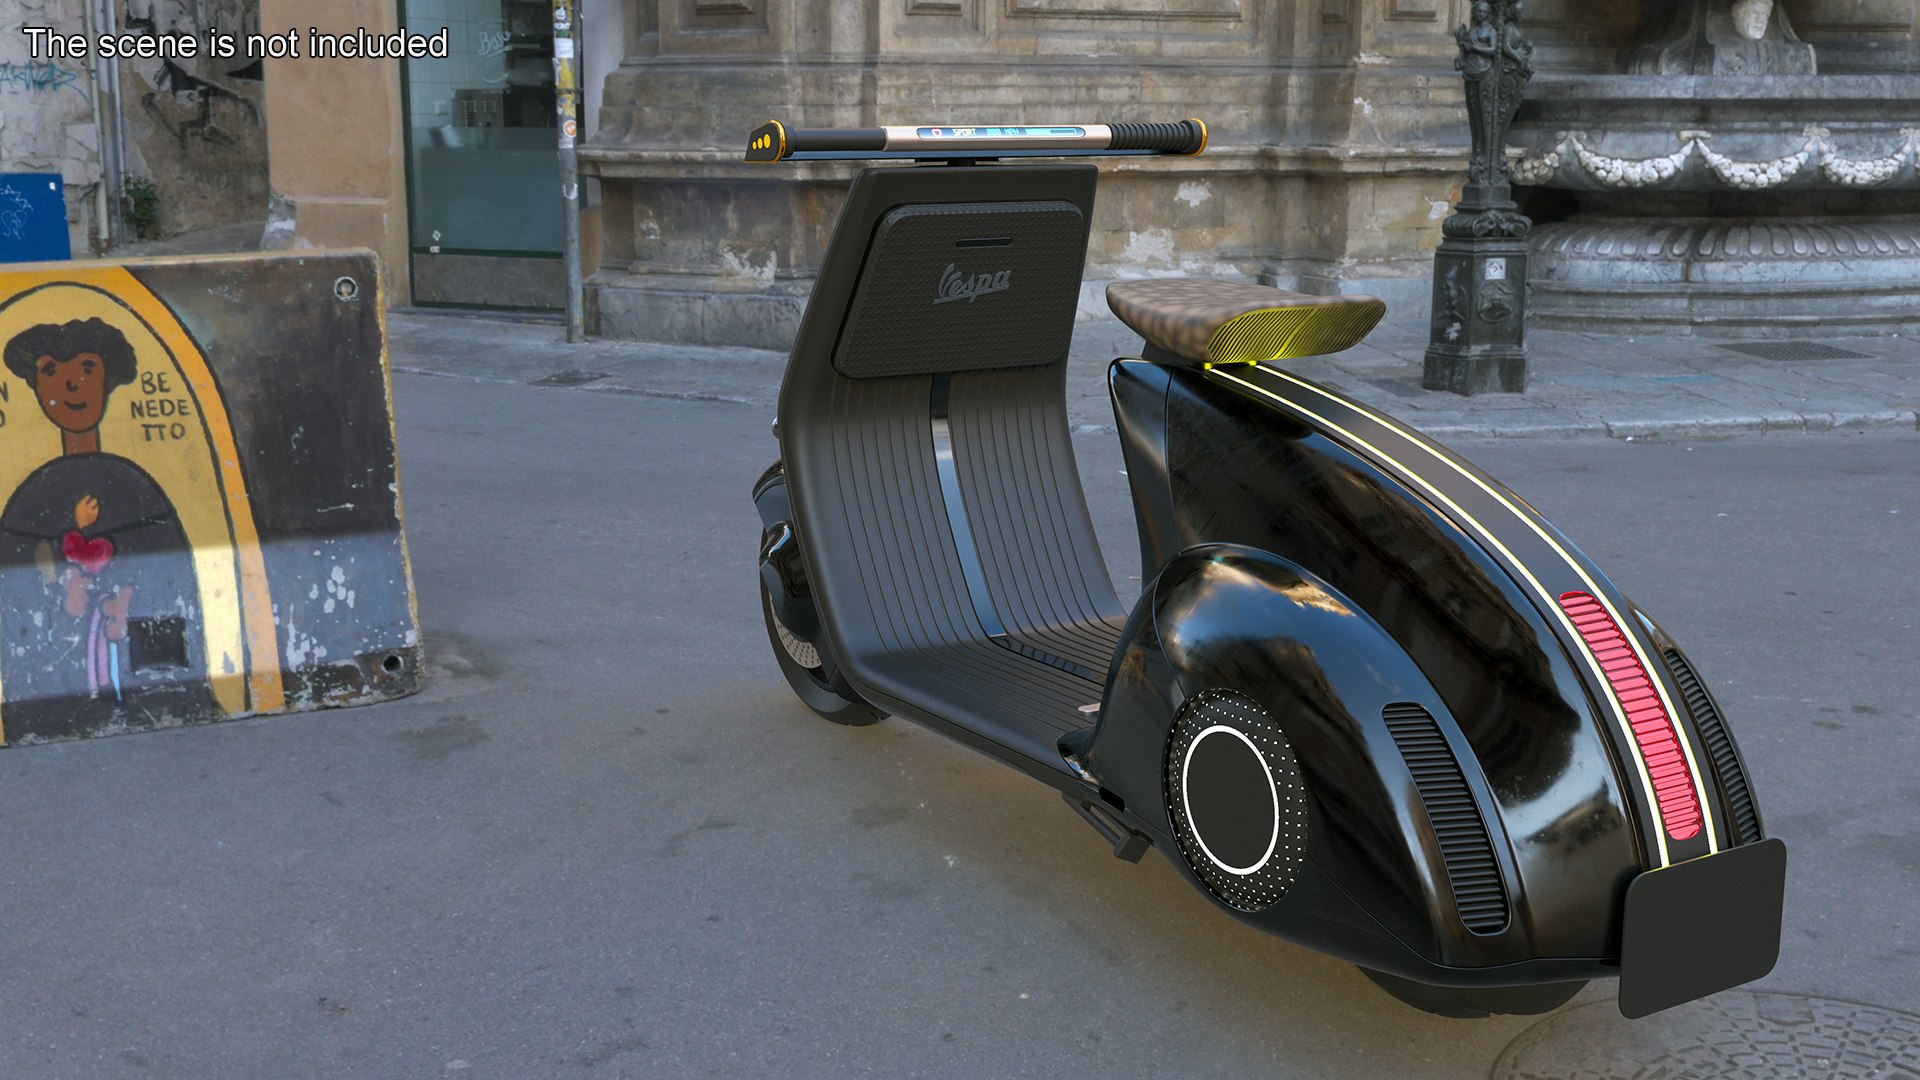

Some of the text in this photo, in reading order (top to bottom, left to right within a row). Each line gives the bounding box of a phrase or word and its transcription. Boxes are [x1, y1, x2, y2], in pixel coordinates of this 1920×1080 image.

[952, 127, 976, 137] SPORT
[932, 263, 1011, 304] Vespa
[141, 372, 171, 395] BE
[131, 399, 191, 418] NEDE
[141, 423, 186, 441] TTO
